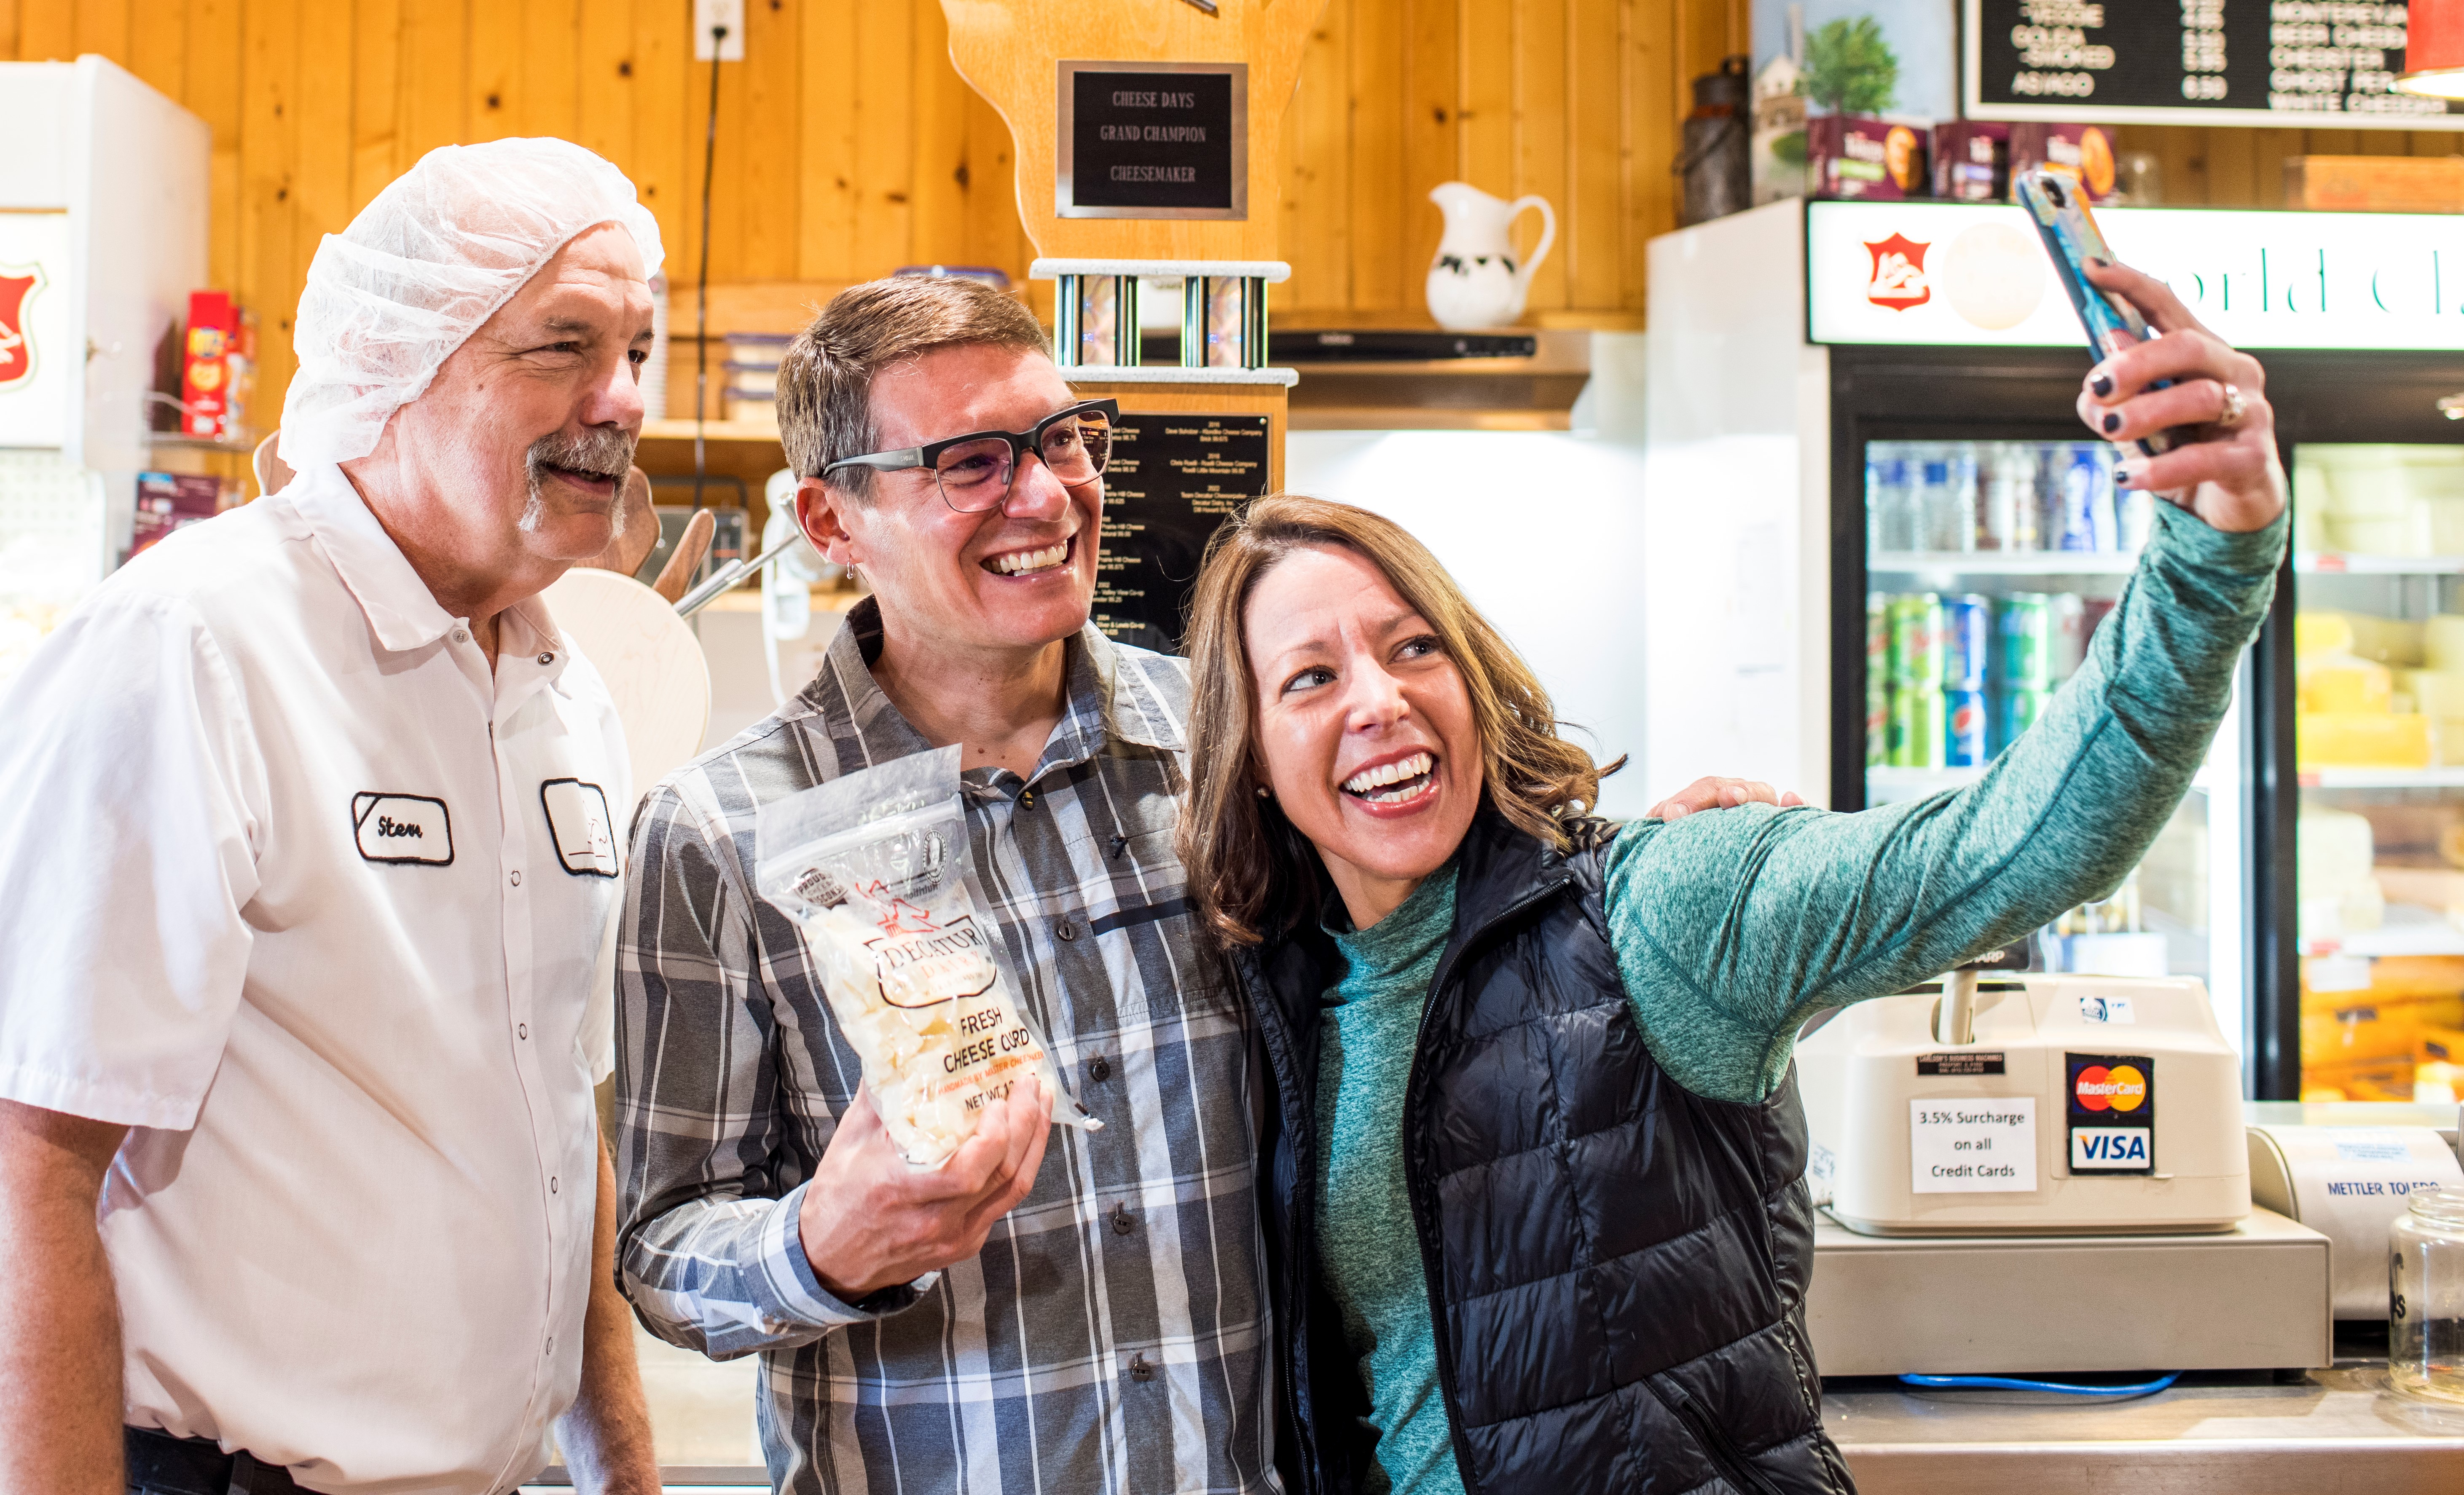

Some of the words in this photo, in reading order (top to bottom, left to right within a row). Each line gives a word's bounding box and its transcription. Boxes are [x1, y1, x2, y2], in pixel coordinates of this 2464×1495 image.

[2011, 24, 2087, 48] GOUDA
[2271, 23, 2330, 46] BEER
[2012, 72, 2095, 97] ASIAGO
[2270, 68, 2345, 91] GHOST
[1113, 91, 1157, 107] CHEESE
[1162, 92, 1194, 108] DAYS
[1100, 126, 1140, 141] GRAND
[1144, 126, 1206, 142] CHAMPION
[1110, 166, 1195, 182] CHEESEMAKER
[2166, 248, 2327, 313] orld
[883, 928, 983, 969] DECATUR
[921, 951, 981, 978] DAIRY
[960, 1007, 1002, 1037] FRESH
[944, 1038, 996, 1073] CHEESE
[1001, 1028, 1029, 1052] CURD
[938, 1077, 974, 1095] HANDMADE
[974, 1072, 982, 1083] BY
[985, 1061, 1009, 1077] MASTER
[2077, 1081, 2144, 1096] MasterCard
[965, 1093, 985, 1111] NET
[1919, 1112, 1953, 1125] 3.5%
[1957, 1112, 2025, 1128] Surcharge
[1954, 1140, 1972, 1151] on
[1975, 1137, 1992, 1151] all
[2077, 1135, 2146, 1160] VISA
[1931, 1164, 1973, 1177] Credit
[1977, 1164, 2015, 1177] Cards
[2327, 1182, 2385, 1195] METTLER
